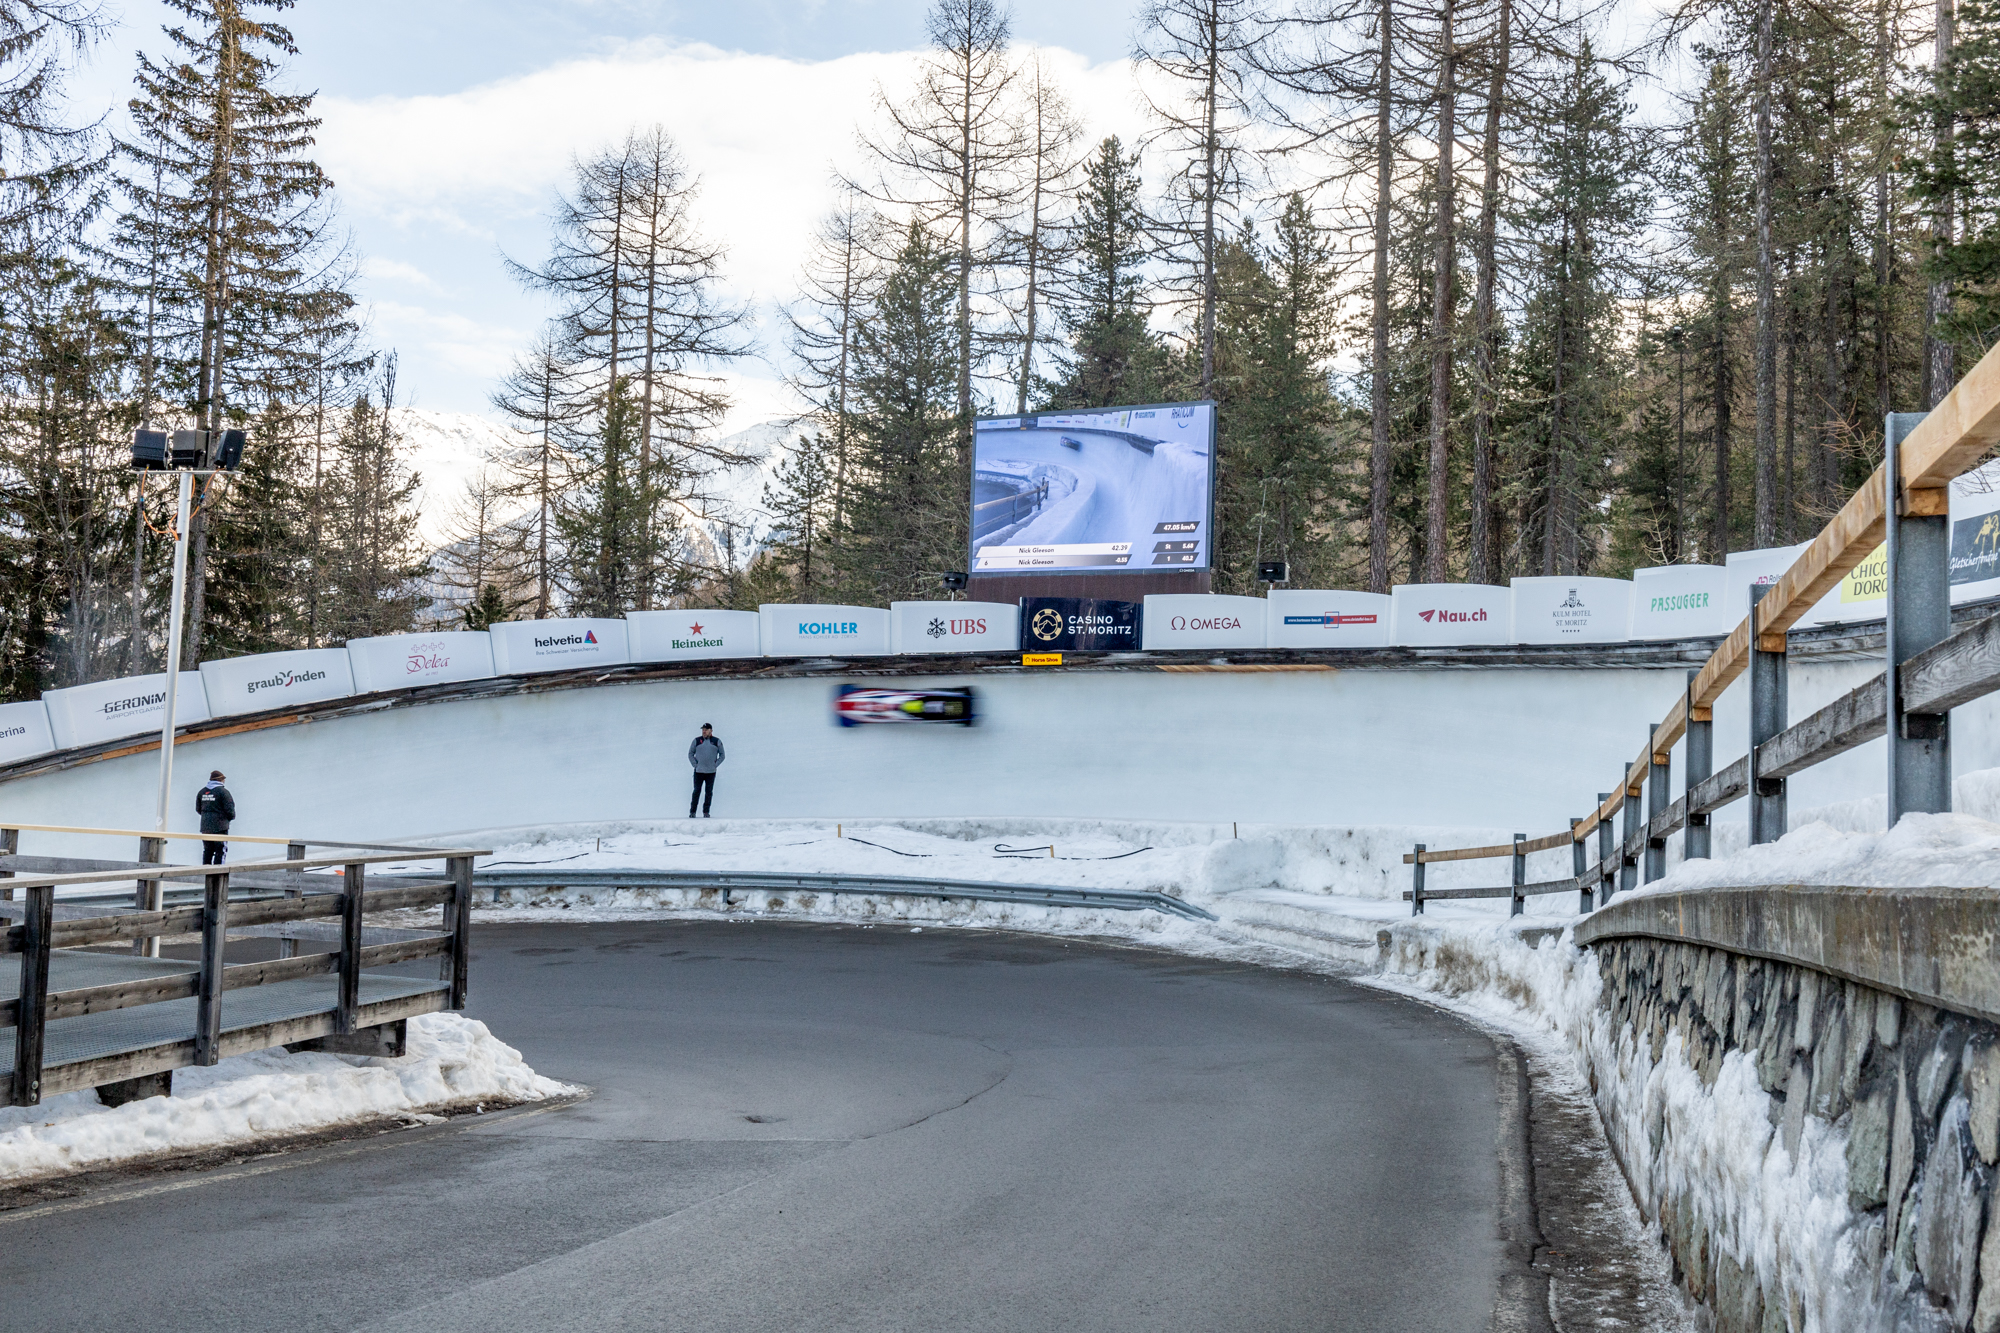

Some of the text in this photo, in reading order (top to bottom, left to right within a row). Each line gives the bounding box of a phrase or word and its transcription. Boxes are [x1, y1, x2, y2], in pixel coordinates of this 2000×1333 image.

[1651, 592, 1709, 612] PASSUGGER
[1068, 615, 1113, 625] CASINO
[1438, 608, 1487, 623] Nau.ch
[1552, 610, 1570, 618] KULM
[799, 622, 858, 634] KOHLER
[950, 618, 987, 635] UBS
[1068, 625, 1132, 635] ST. MORITZ
[1190, 617, 1241, 630] OMEGA
[535, 634, 582, 647] helvetia
[672, 638, 723, 649] Heineken
[406, 653, 450, 674] Delea
